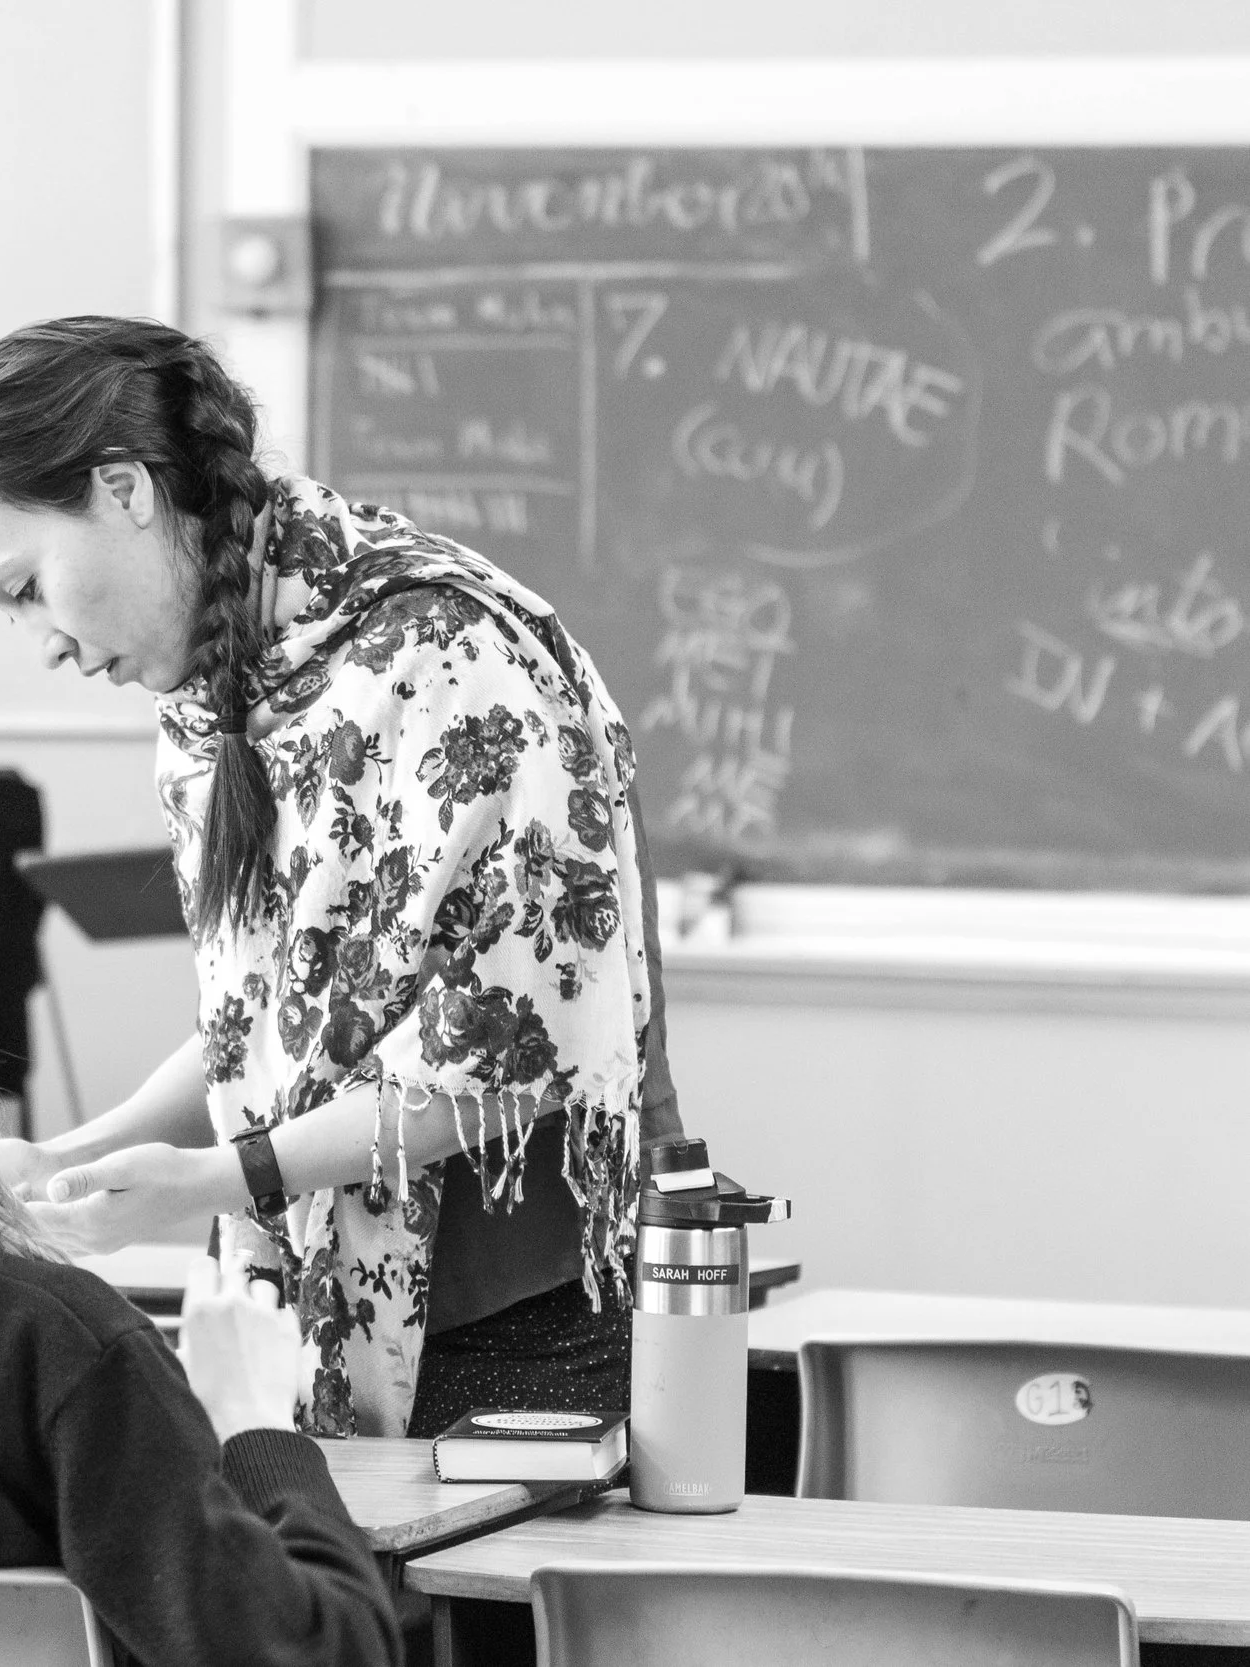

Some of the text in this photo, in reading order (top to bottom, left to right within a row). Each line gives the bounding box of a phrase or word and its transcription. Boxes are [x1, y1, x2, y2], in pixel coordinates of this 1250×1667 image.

[1150, 164, 1250, 285] Pr
[1046, 383, 1250, 486] Rom
[652, 1266, 728, 1281] SARAH HOFF
